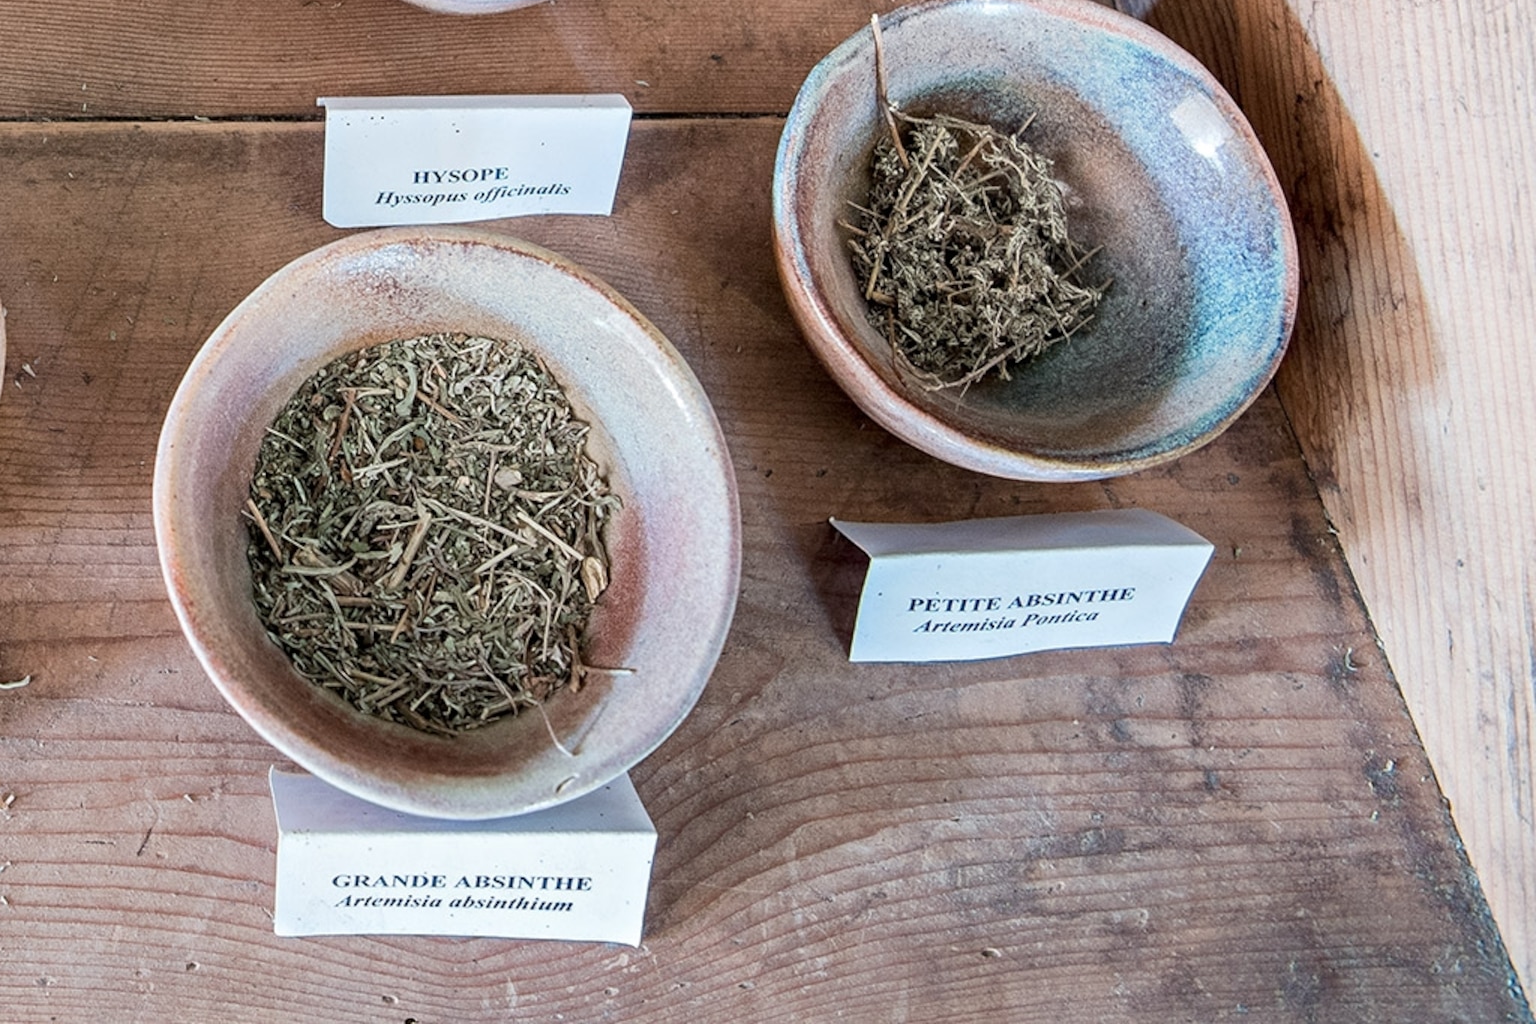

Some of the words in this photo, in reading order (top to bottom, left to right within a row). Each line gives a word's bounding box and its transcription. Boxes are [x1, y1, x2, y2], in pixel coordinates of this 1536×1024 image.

[413, 167, 510, 185] HYSOPE
[374, 191, 469, 208] Hyssopus
[473, 183, 572, 203] officinalis
[907, 597, 1003, 613] PETITE
[1007, 587, 1136, 610] ABSINTHE
[912, 616, 1017, 633] Artemisia
[1021, 610, 1101, 628] Pontica
[331, 874, 447, 888] GRANDE
[454, 875, 593, 891] ABSINTHE
[334, 894, 443, 908] Artemisia
[448, 895, 574, 912] absinthium
